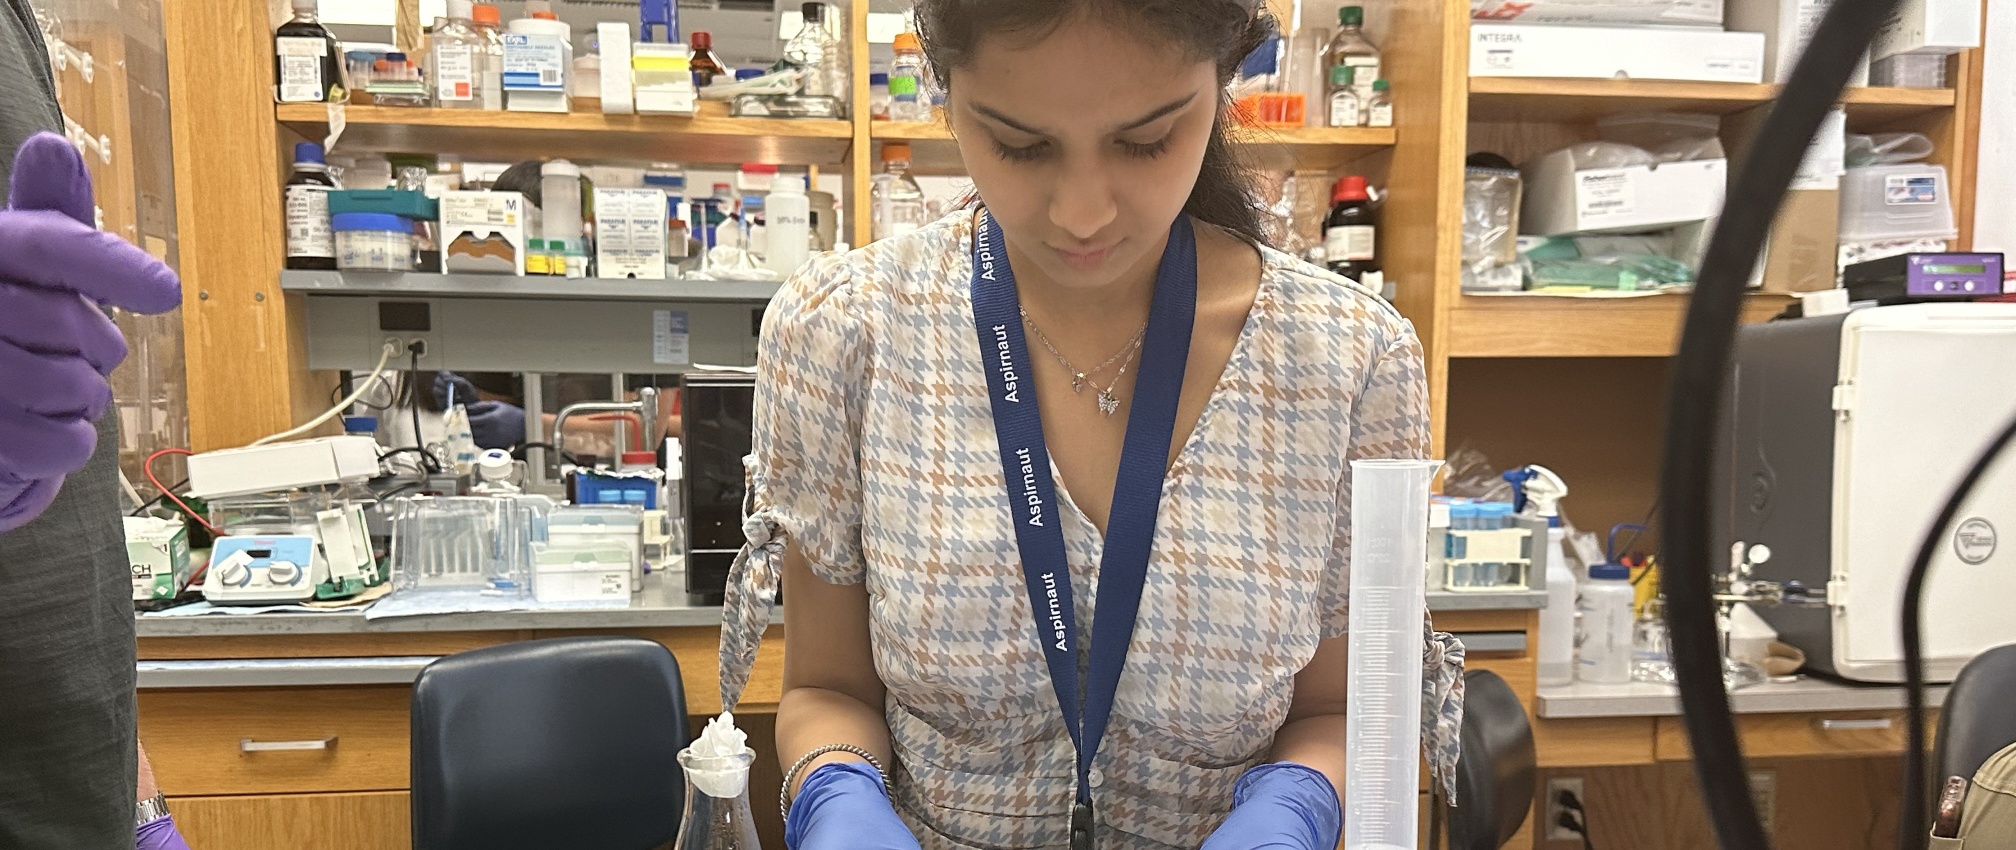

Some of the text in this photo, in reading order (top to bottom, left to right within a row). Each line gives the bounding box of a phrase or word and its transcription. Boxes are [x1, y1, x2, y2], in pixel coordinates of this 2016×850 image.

[1477, 33, 1522, 43] INTEGRA
[992, 324, 1020, 403] Aspirnaut
[1015, 447, 1044, 527] Aspirnaut
[131, 564, 152, 574] CH
[1041, 572, 1068, 652] Aspirnaut
